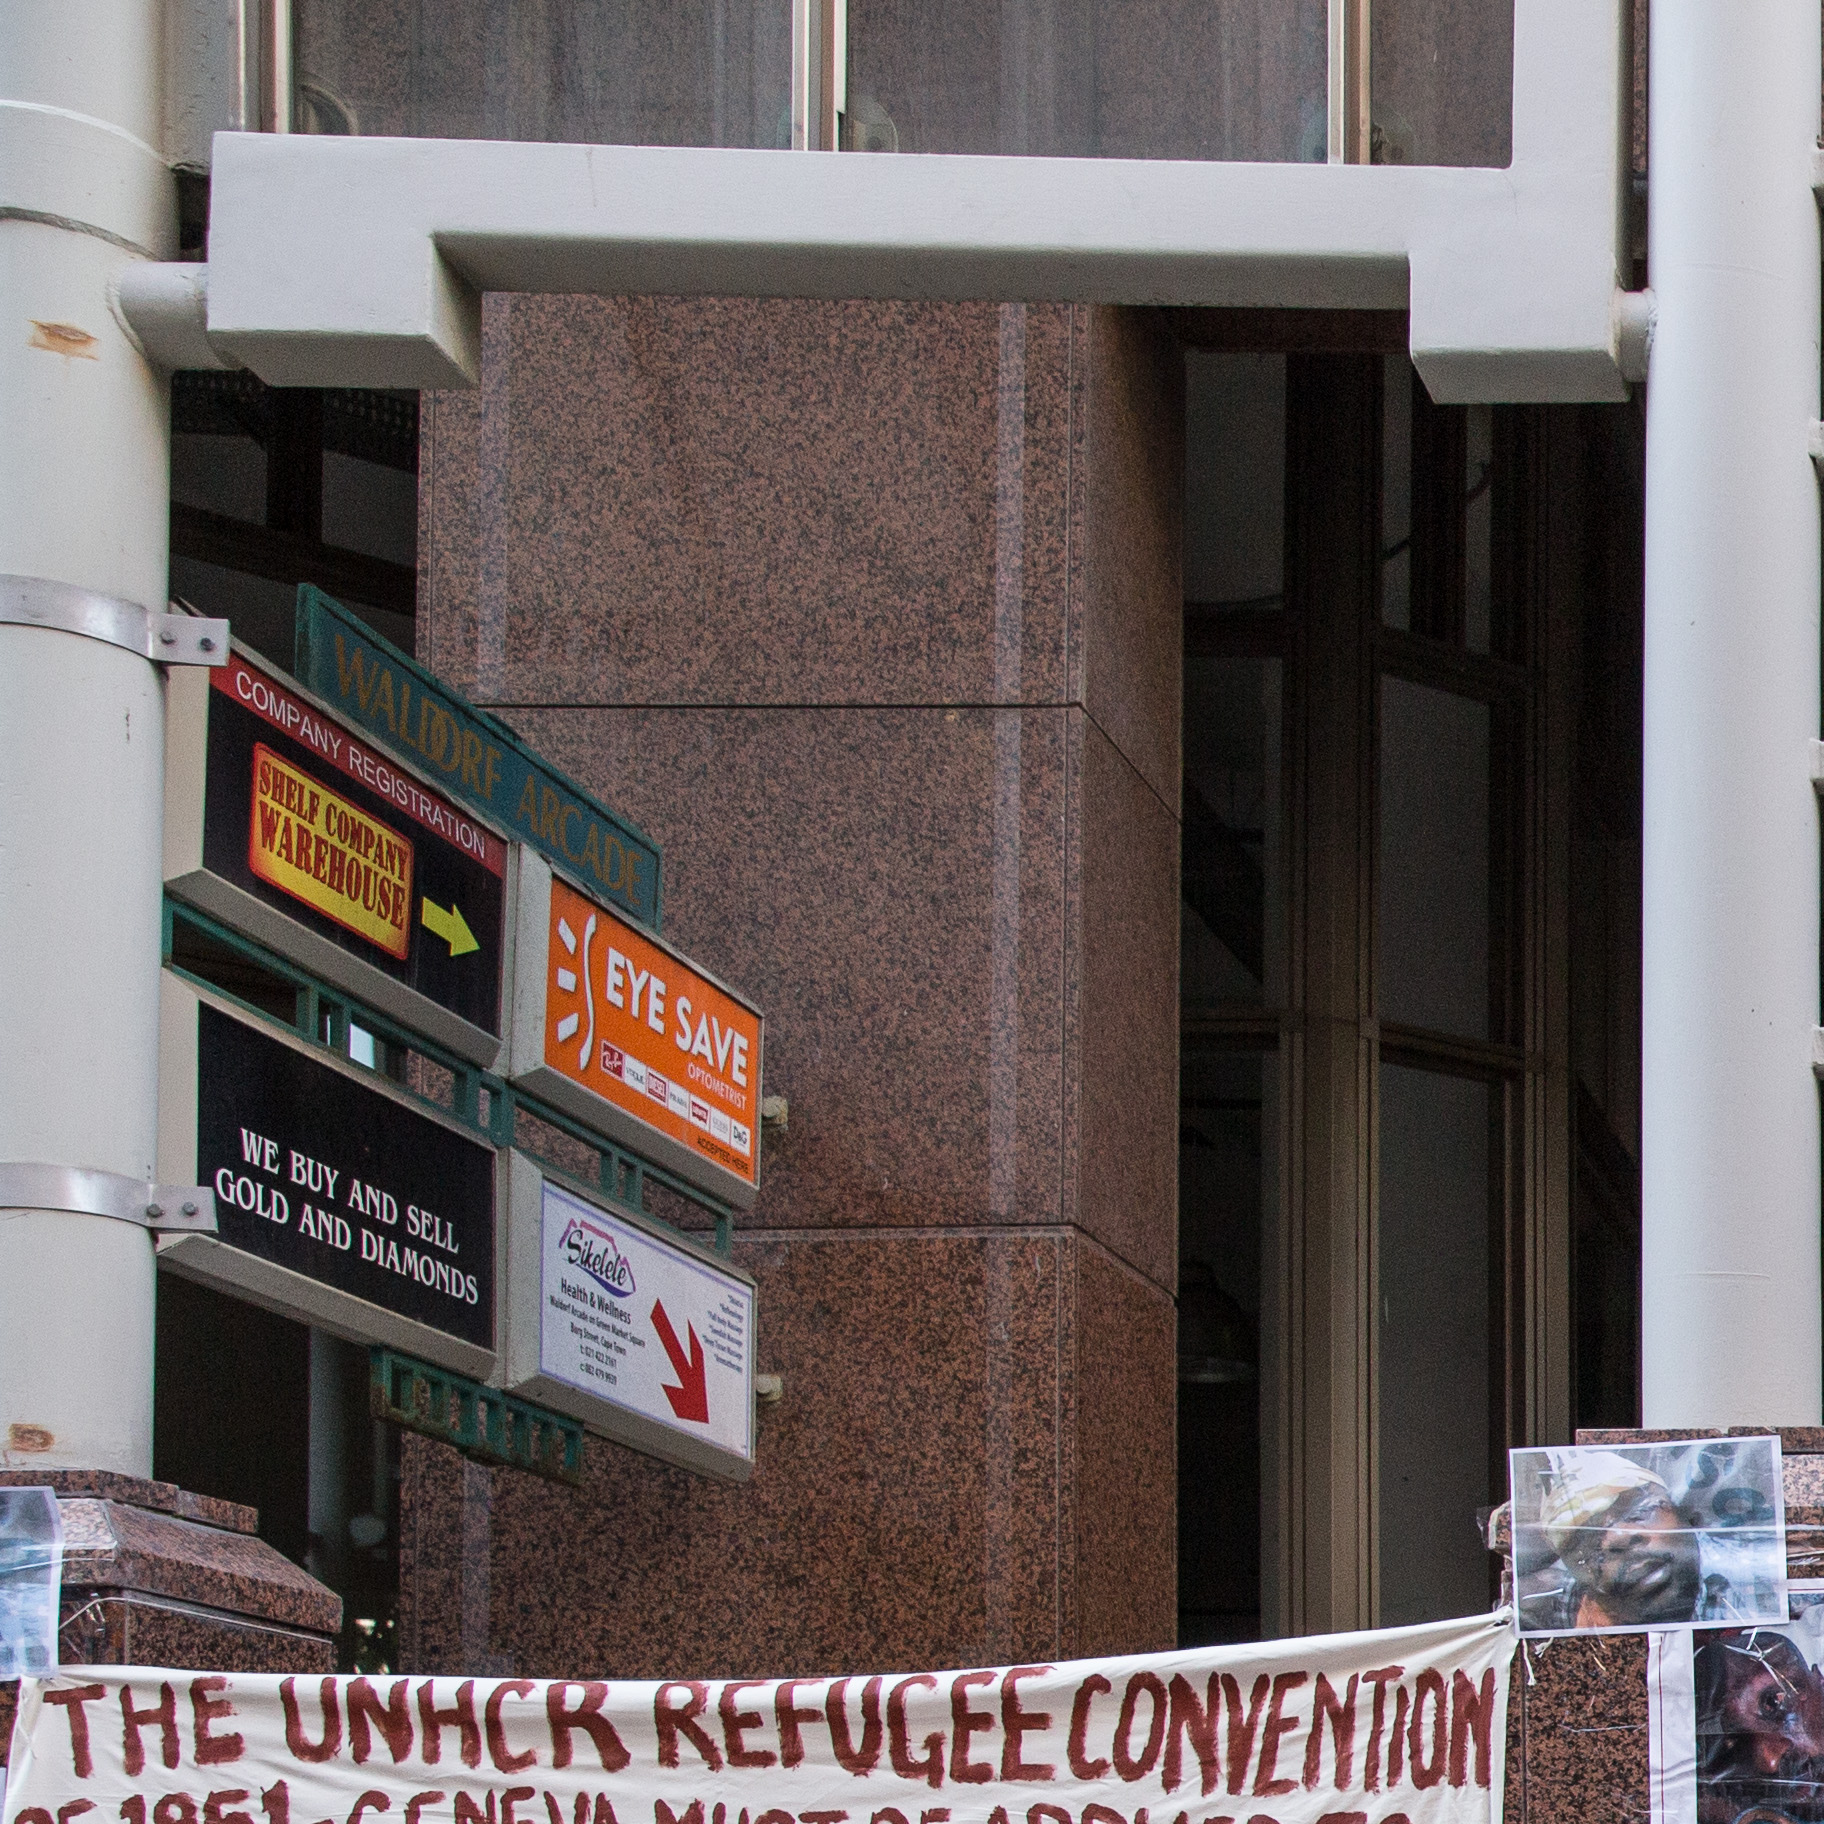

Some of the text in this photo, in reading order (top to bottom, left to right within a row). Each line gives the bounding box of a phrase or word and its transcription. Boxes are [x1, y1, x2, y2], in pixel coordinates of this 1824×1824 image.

[235, 670, 486, 860] COMPANY REGISTRATION
[258, 759, 408, 882] SHELF COMPANY
[334, 634, 643, 908] WALDORF ARCADE
[258, 800, 406, 931] WAREHOUSE
[605, 946, 749, 1088] EYE SAVE
[687, 1061, 747, 1111] OPTOMETRIST
[214, 1167, 479, 1306] GOLD AND DIAMONDS
[240, 1126, 460, 1255] WE BUY AND SELL
[561, 1277, 632, 1325] Health & Wellness
[566, 1228, 627, 1287] Sikelele
[42, 1664, 1498, 1797] THE UNHCR REFUGEE CONVENTION
